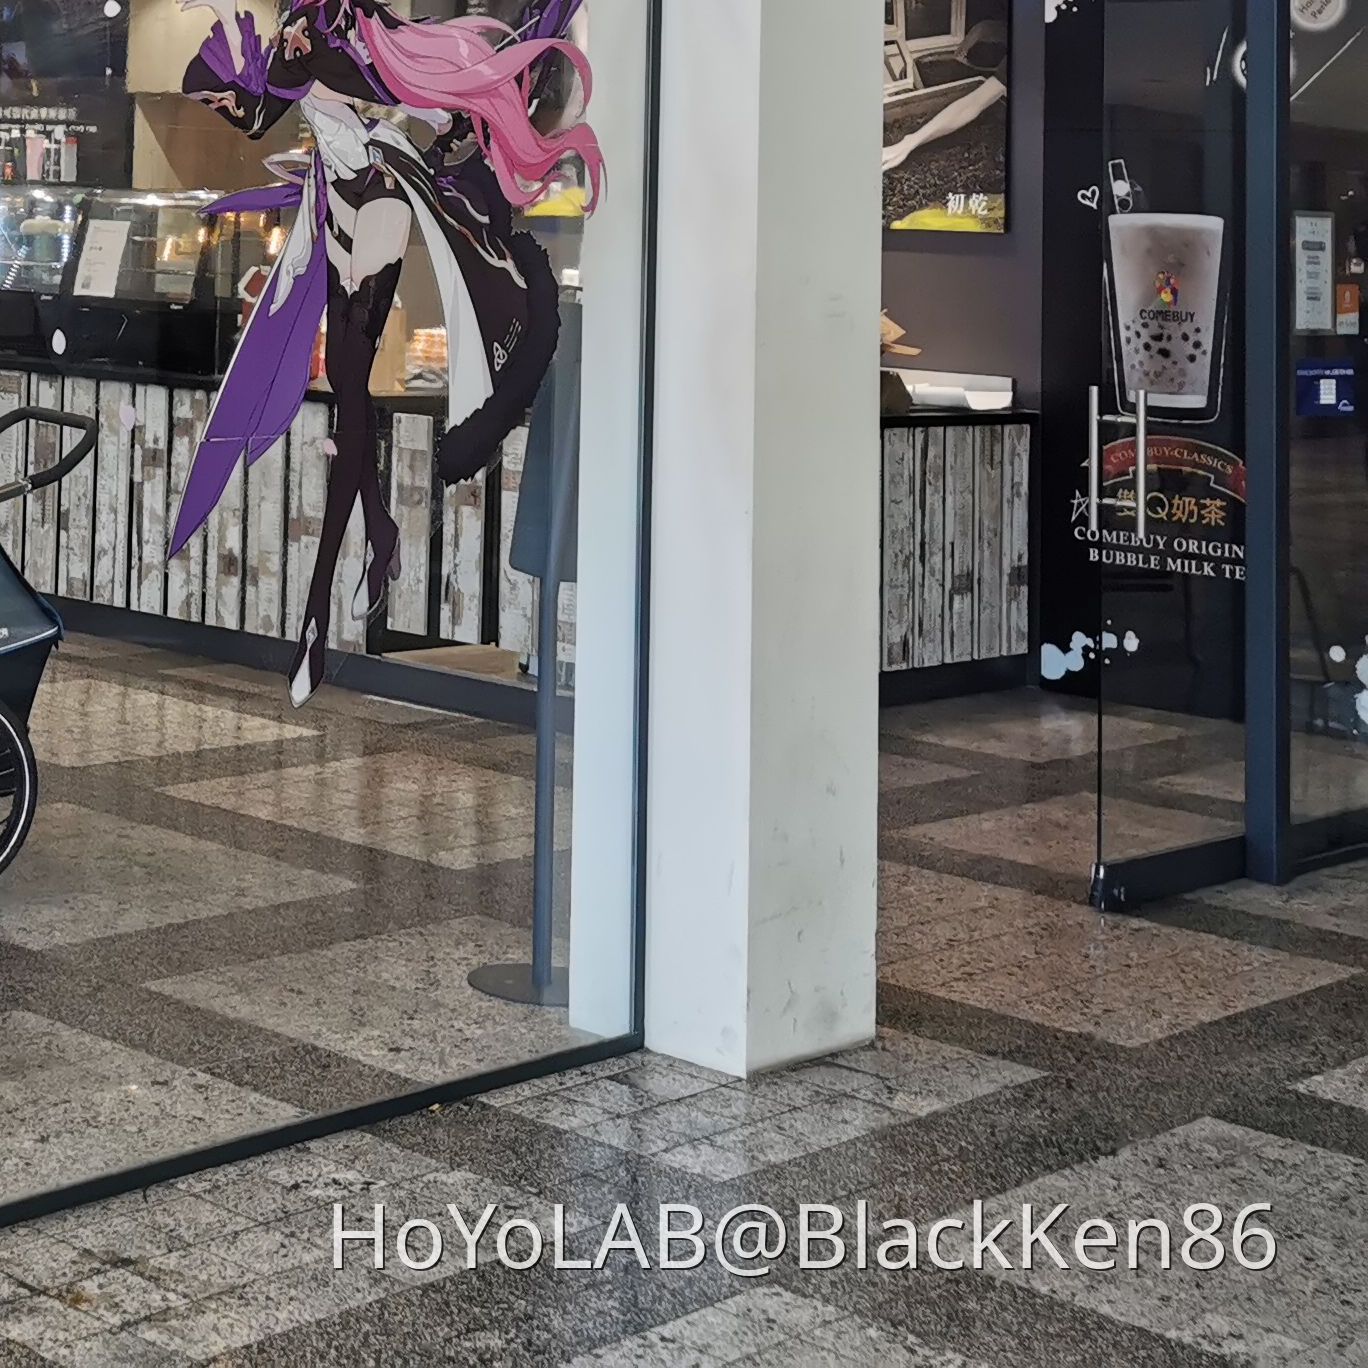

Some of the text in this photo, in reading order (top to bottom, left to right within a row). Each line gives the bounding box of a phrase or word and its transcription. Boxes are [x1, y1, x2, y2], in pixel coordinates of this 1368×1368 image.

[1139, 308, 1196, 323] COMEBUY
[1110, 445, 1172, 464] COMBUY
[1088, 547, 1161, 570] BUBBLE
[1166, 557, 1217, 578] MILK
